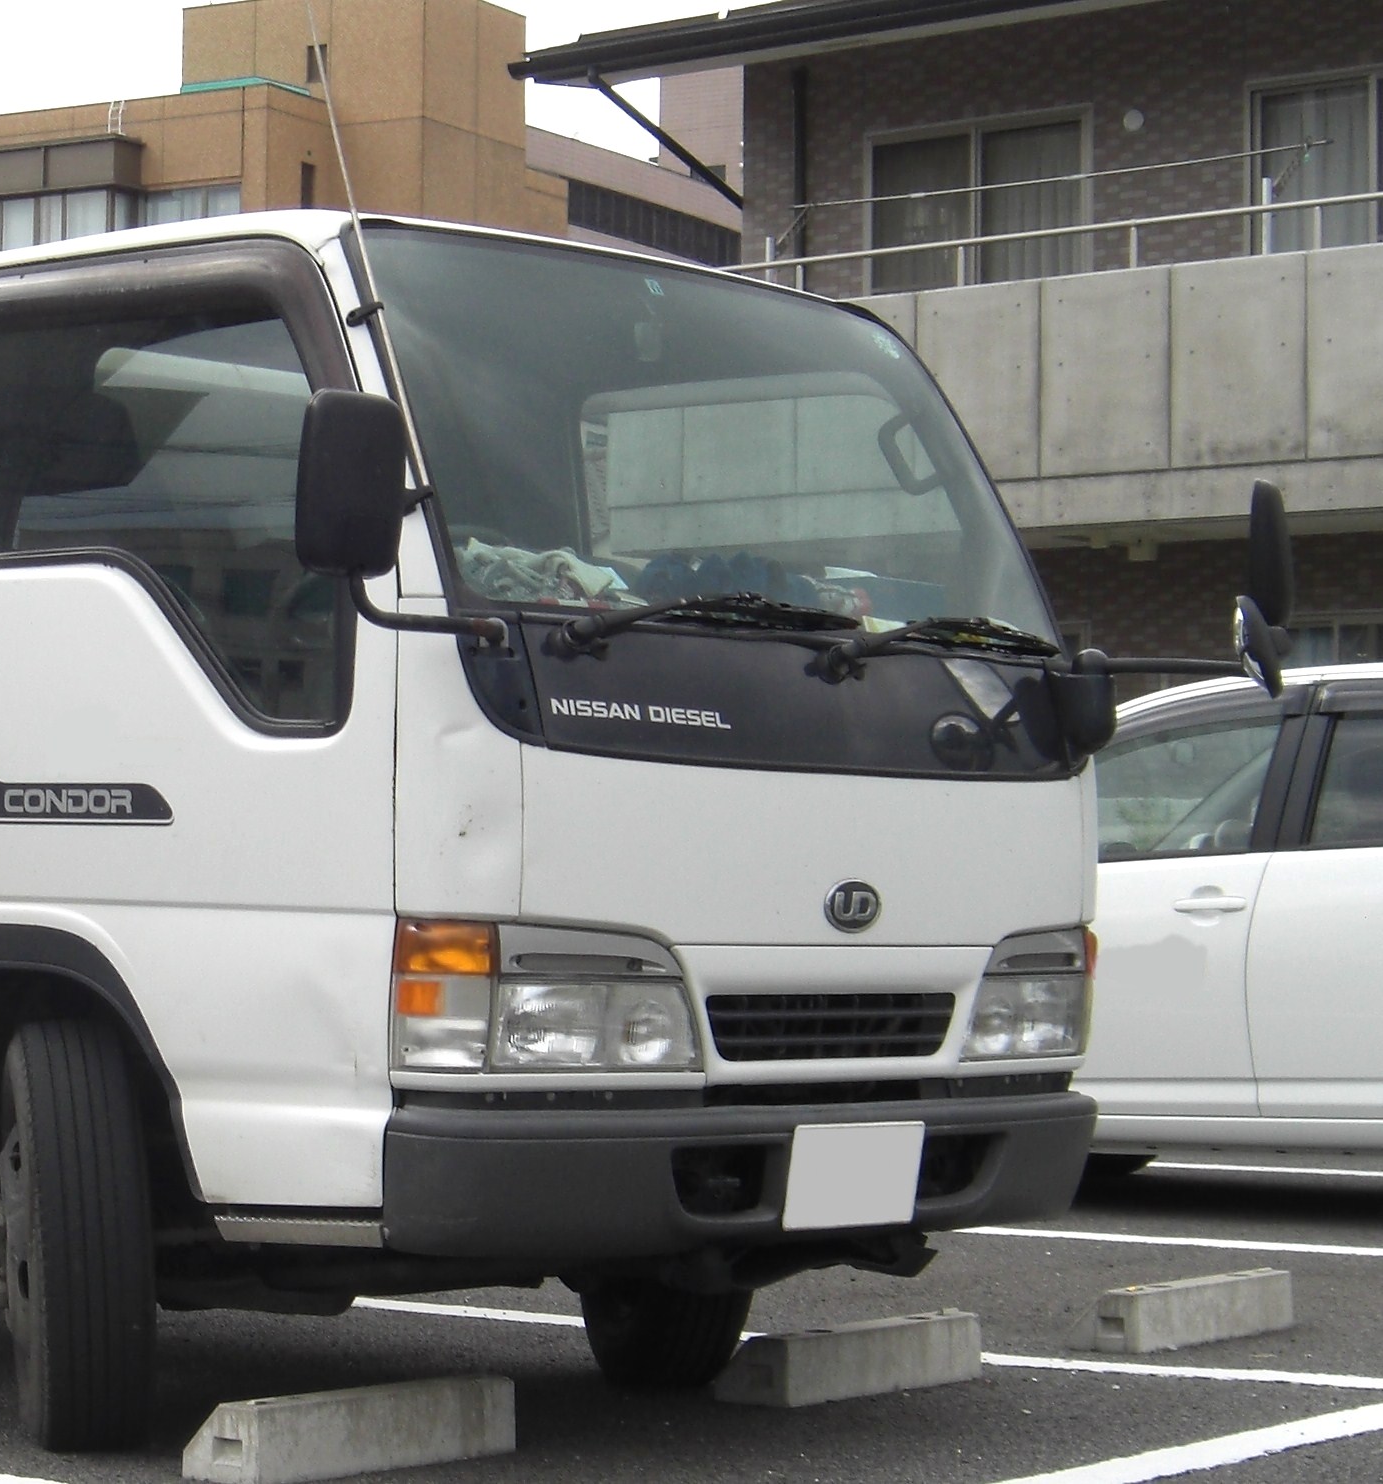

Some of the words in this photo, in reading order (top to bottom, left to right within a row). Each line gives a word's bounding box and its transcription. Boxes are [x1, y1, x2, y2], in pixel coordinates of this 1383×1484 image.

[550, 698, 640, 721] NISSAN
[648, 705, 731, 729] DIESEL
[4, 788, 131, 814] CONDOR
[835, 891, 877, 921] UD
